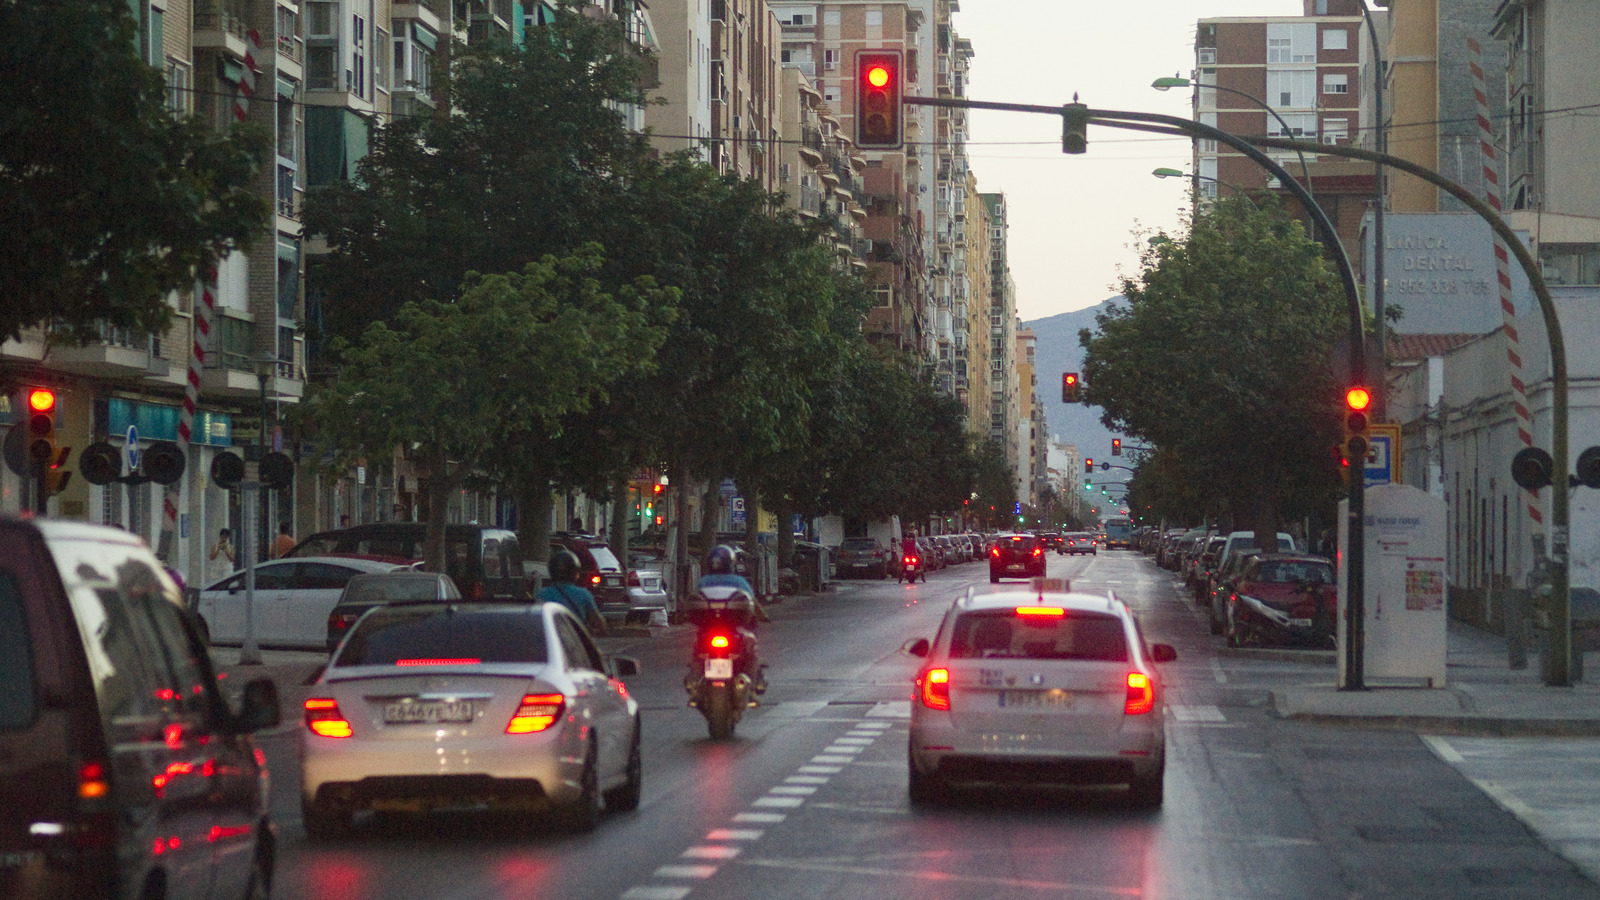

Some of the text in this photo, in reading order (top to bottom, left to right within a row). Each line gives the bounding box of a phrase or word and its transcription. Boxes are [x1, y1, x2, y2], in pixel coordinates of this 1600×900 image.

[1382, 234, 1449, 250] LINICA
[1403, 255, 1474, 272] DENTAL
[1399, 278, 1426, 295] 952
